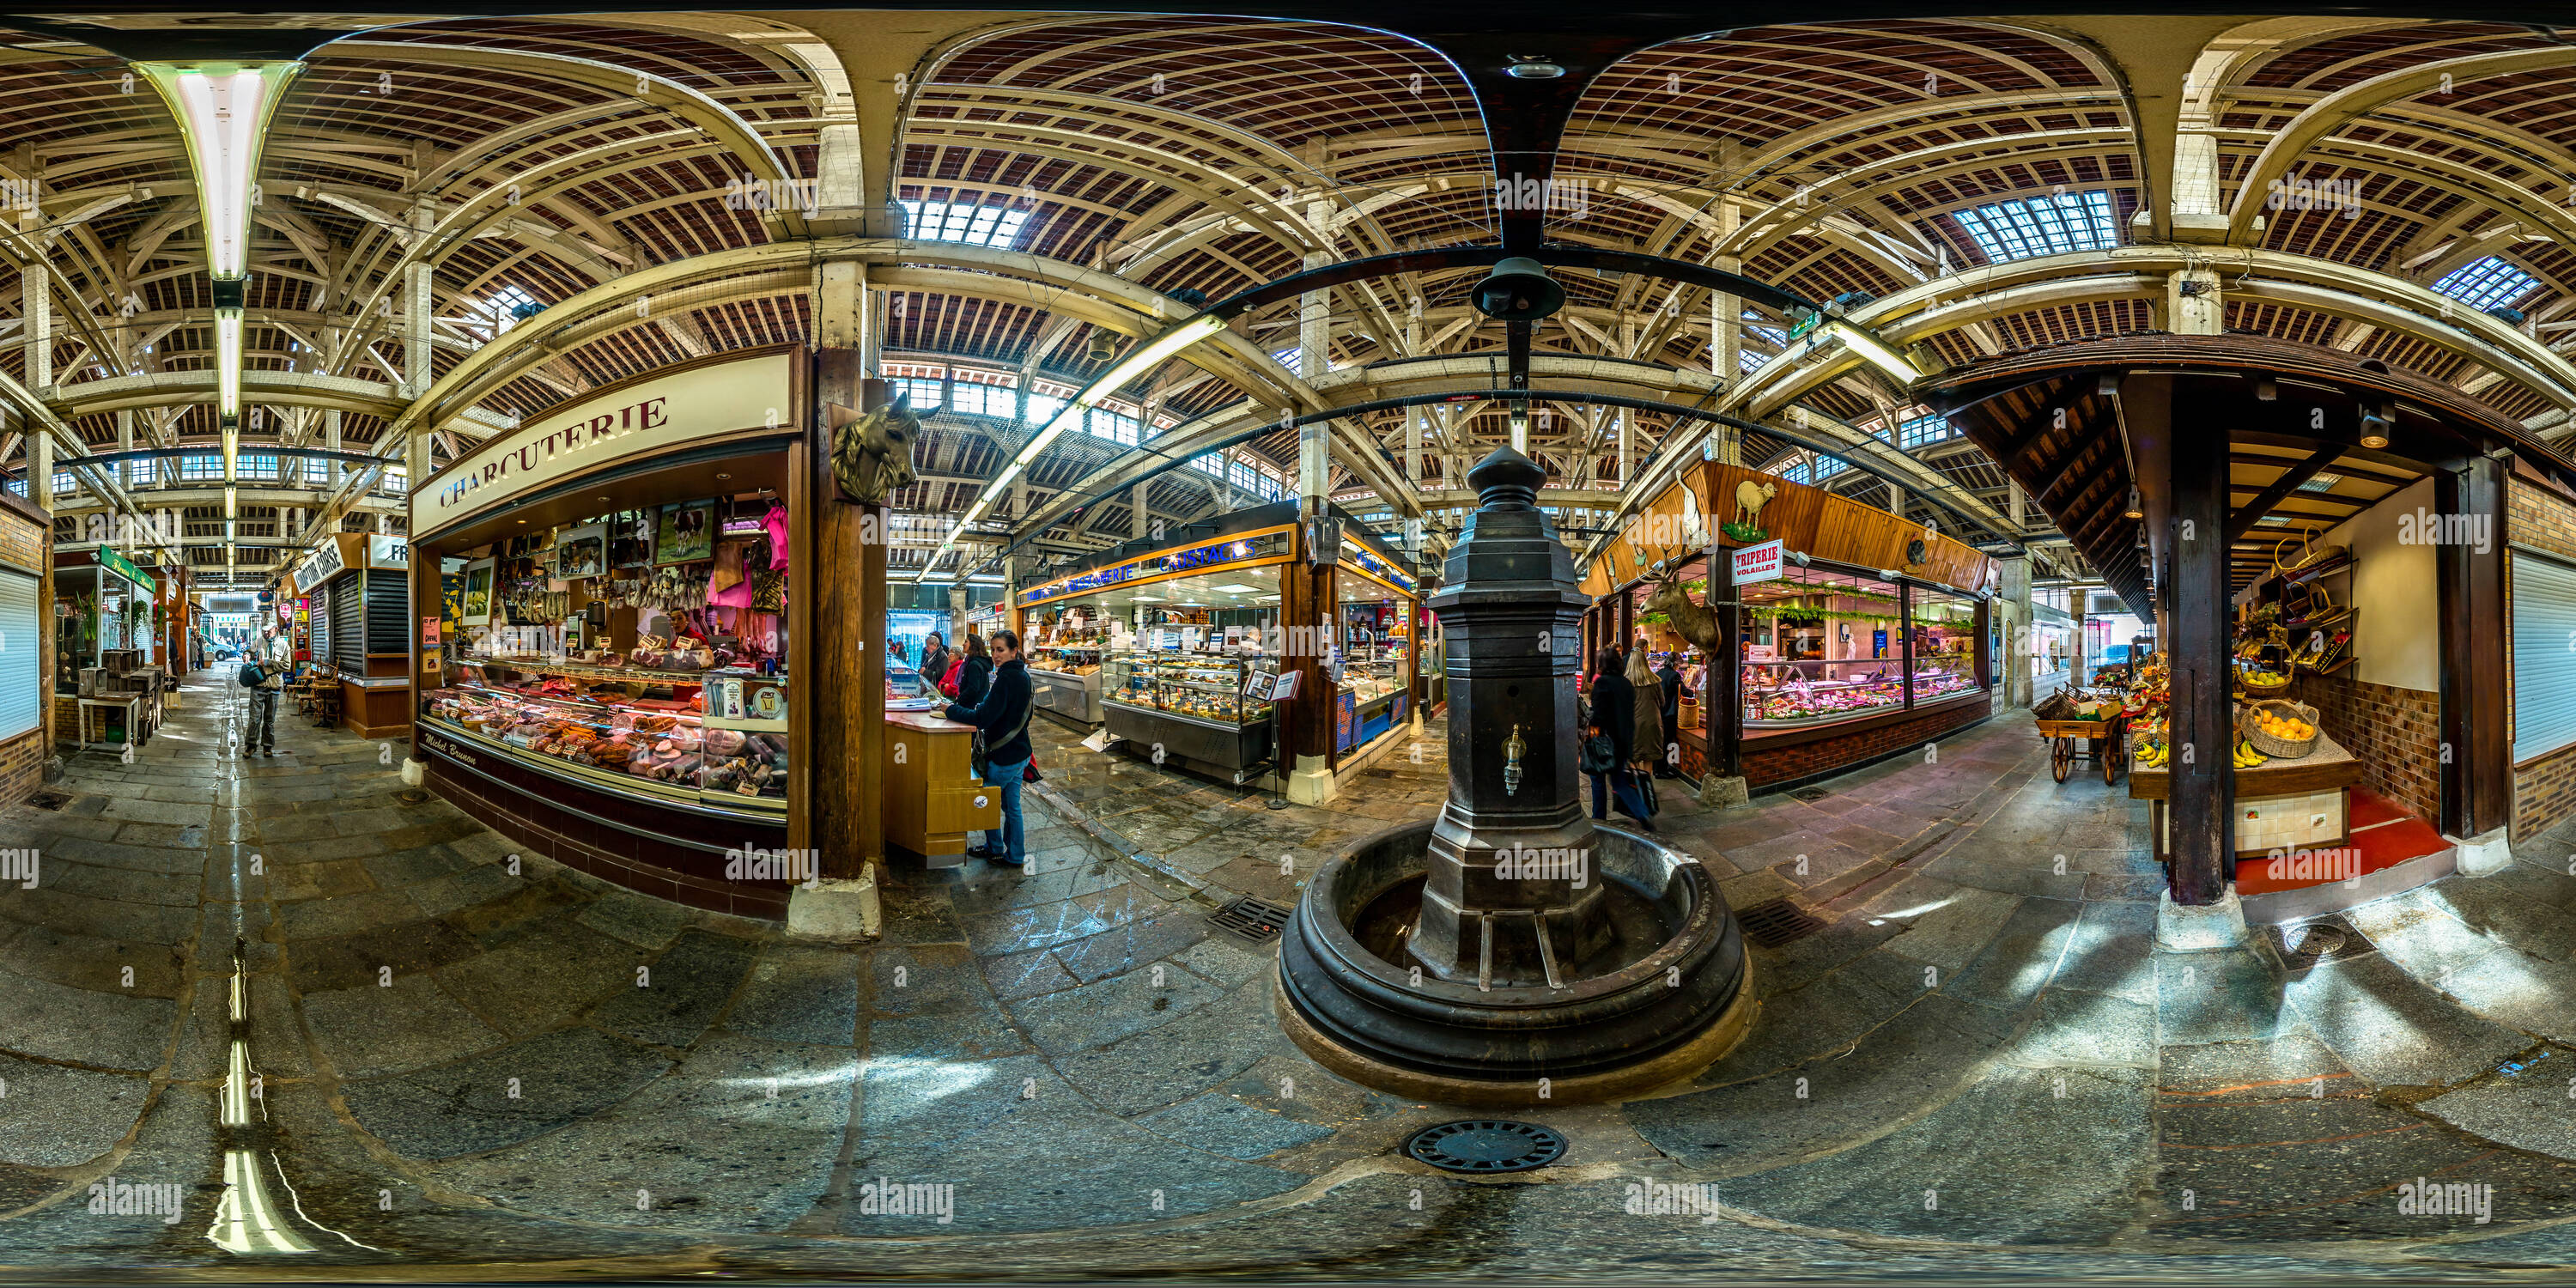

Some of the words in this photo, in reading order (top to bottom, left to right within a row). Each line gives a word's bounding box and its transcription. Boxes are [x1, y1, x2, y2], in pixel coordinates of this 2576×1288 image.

[440, 397, 668, 509] CHARCUTERIE
[316, 544, 341, 578] CORSE
[1735, 546, 1777, 568] TRIPERIE
[1736, 563, 1776, 576] VOLAILLES
[425, 732, 447, 751] Michel
[449, 744, 477, 765] Brunon
